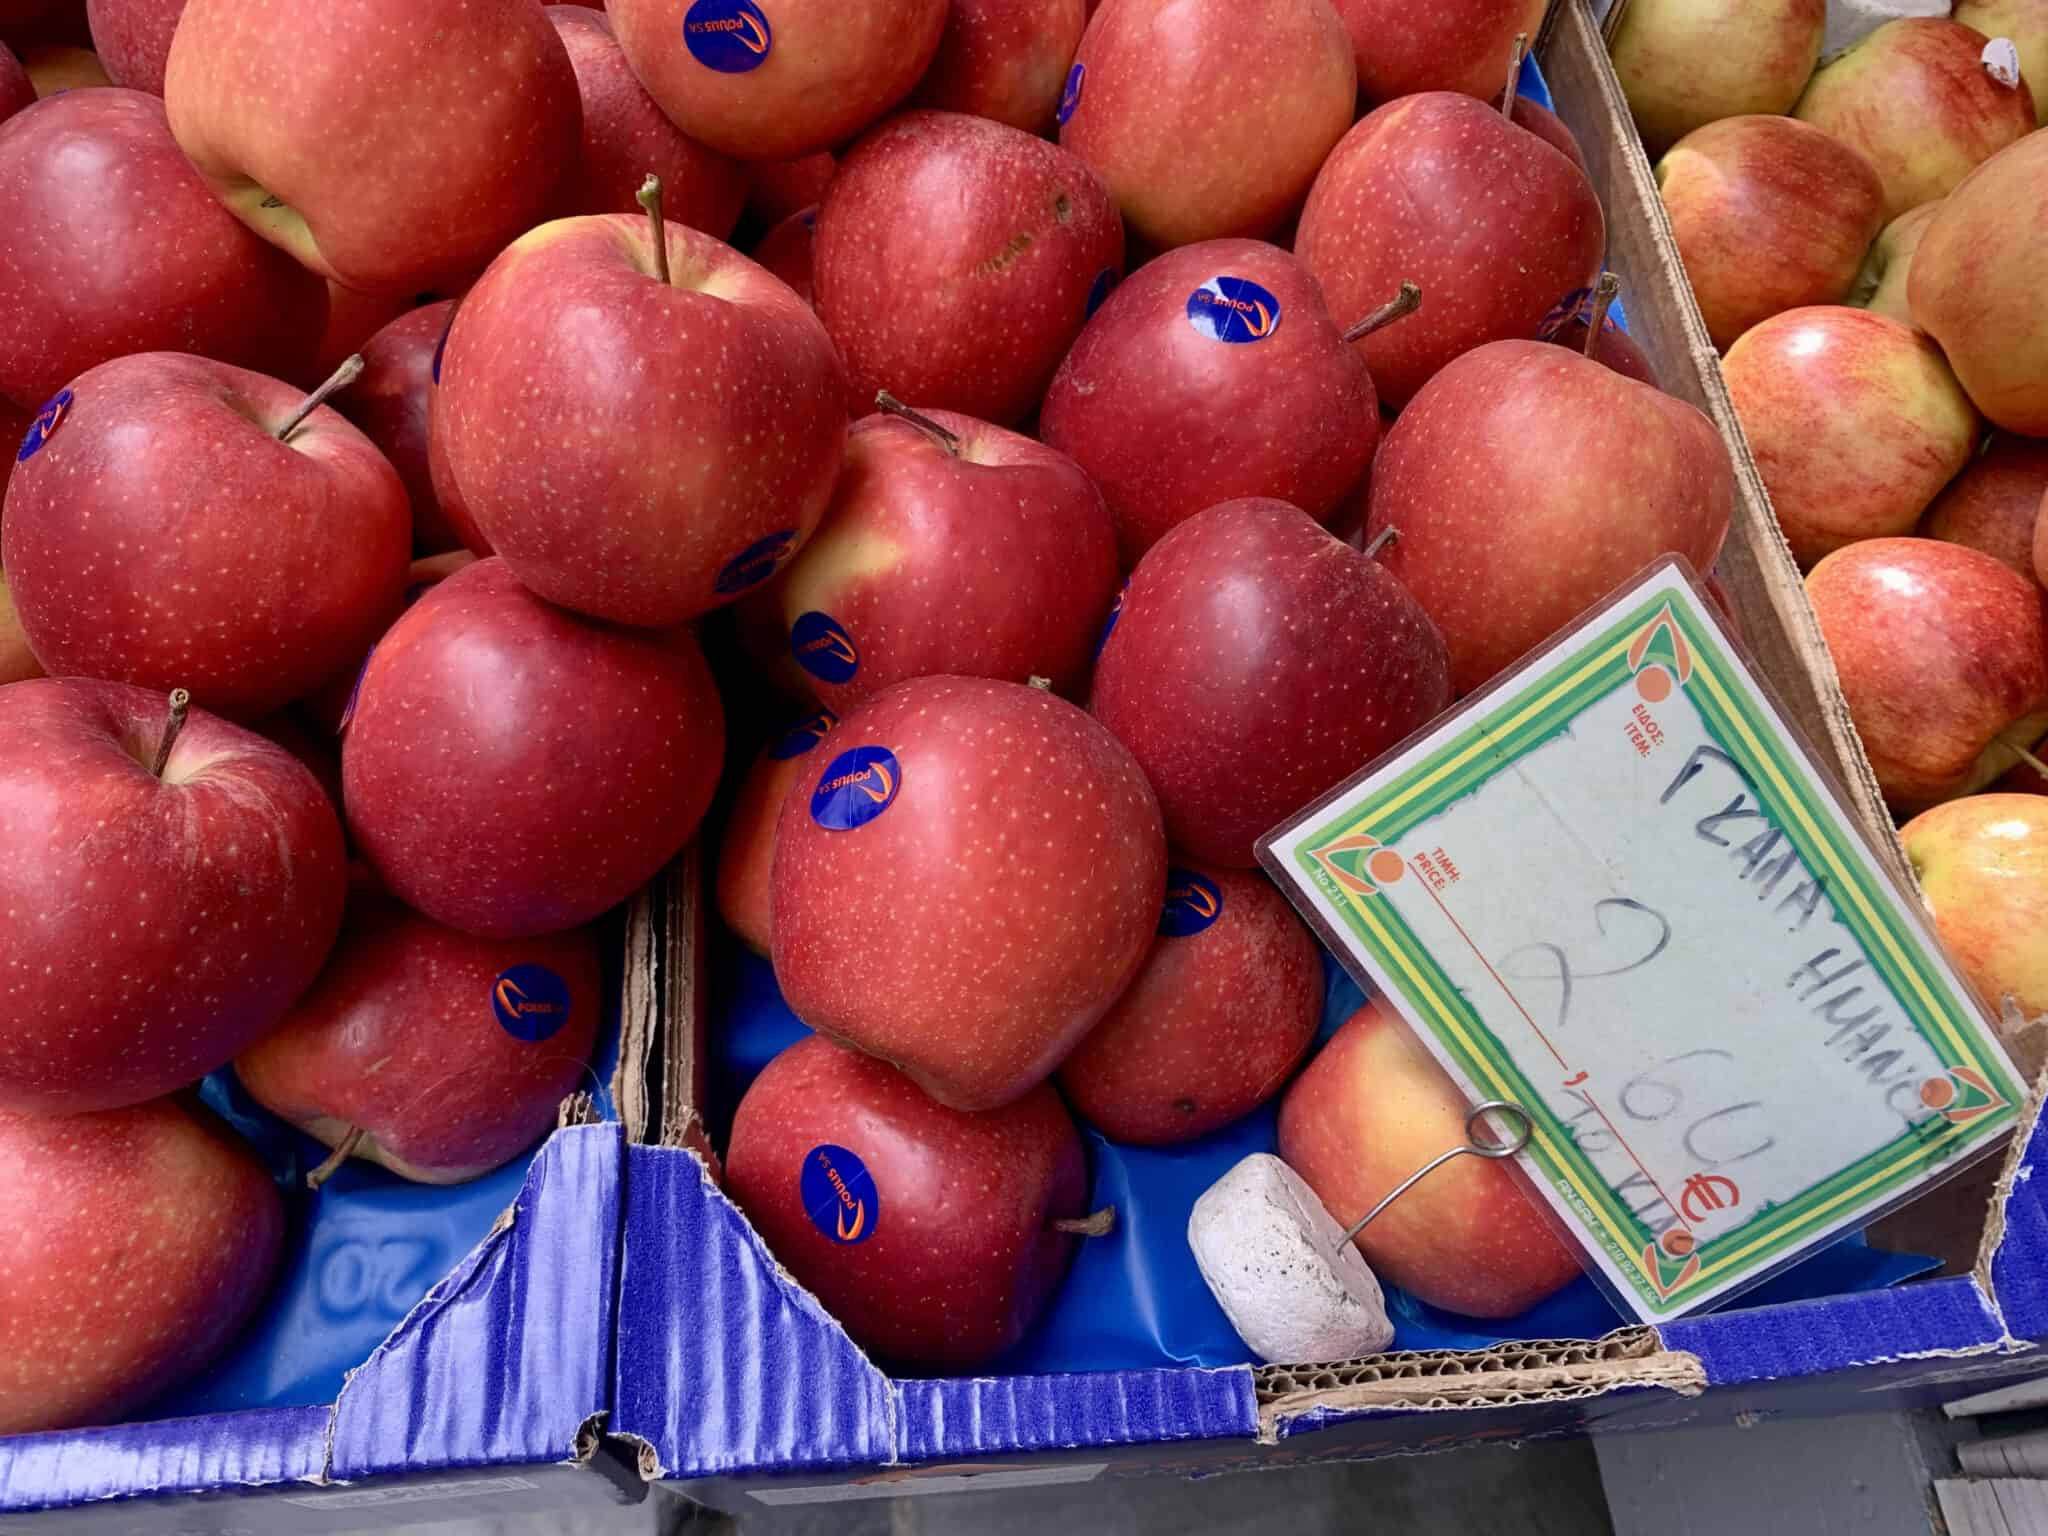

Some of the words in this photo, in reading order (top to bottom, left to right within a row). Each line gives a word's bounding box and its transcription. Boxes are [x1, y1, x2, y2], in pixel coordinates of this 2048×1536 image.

[704, 18, 744, 33] POULIS
[1214, 297, 1255, 313] POULIS
[1623, 720, 1651, 759] ITEM:
[831, 768, 872, 790] POULIS
[1413, 851, 1447, 890] PRICE:
[826, 1167, 858, 1211] POULIS
